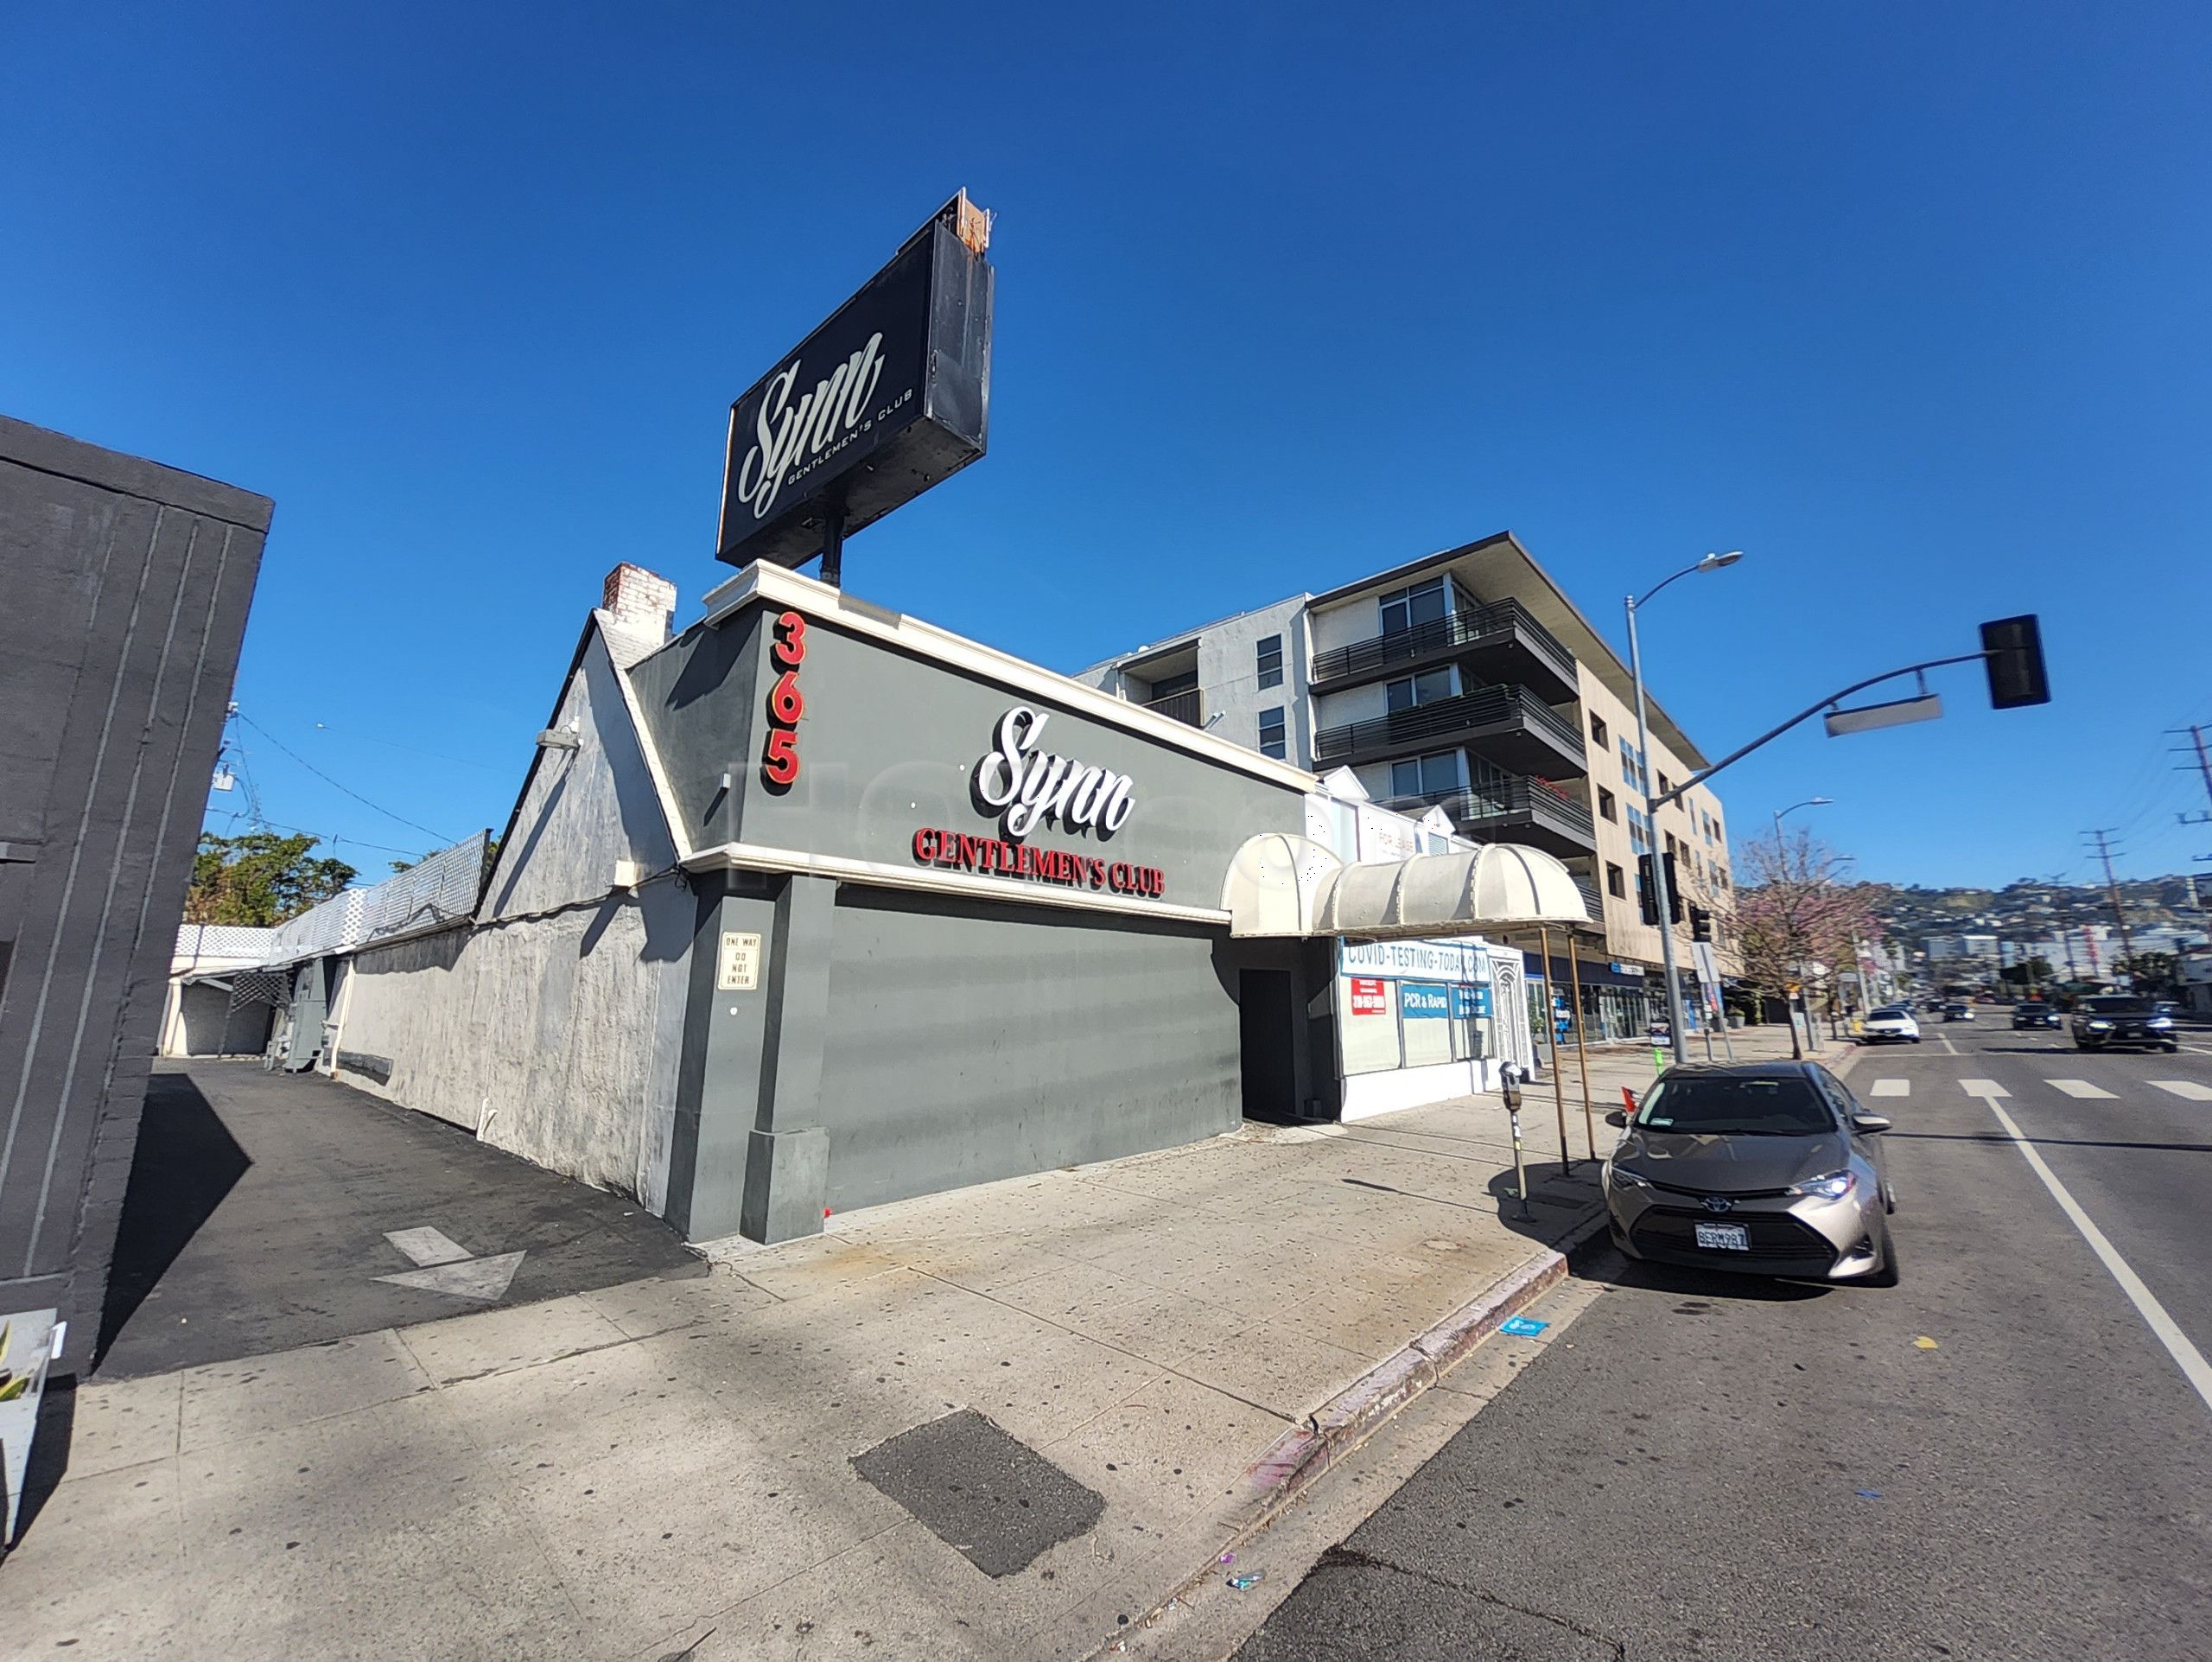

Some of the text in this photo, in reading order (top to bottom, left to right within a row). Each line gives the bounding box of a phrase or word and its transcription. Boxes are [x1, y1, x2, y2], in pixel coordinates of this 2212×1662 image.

[787, 388, 913, 486] GENTLEMEN'S CLUB
[766, 610, 807, 785] 365
[913, 827, 1166, 895] GENTLEMEN'S CLUB
[726, 937, 757, 947] ONE WAY
[735, 952, 747, 962] DO
[731, 964, 747, 973] NOT
[727, 975, 750, 984] ENTER
[1403, 992, 1421, 1009] PCR
[1421, 996, 1427, 1009] &
